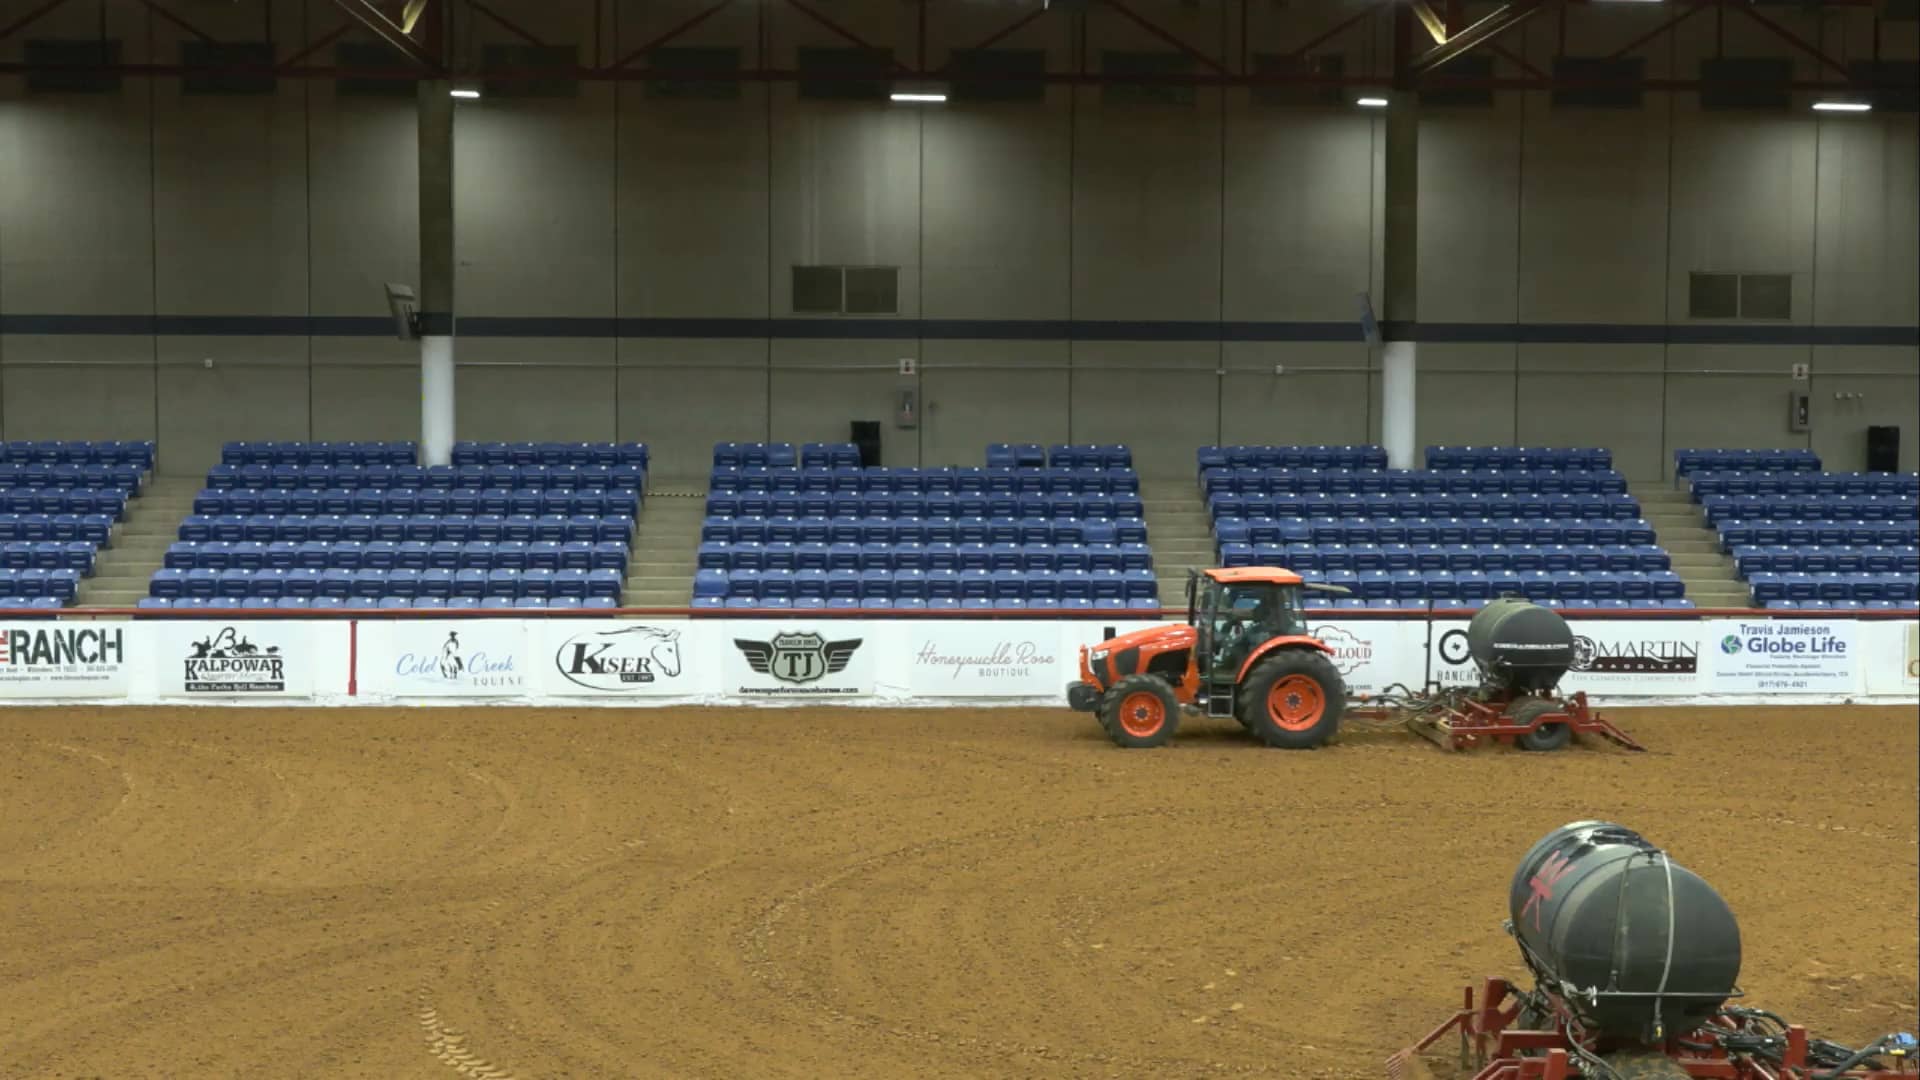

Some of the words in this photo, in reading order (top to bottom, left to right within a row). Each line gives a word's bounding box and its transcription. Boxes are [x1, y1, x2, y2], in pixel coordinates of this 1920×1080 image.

[1740, 624, 1773, 635] Travis
[1777, 624, 1830, 635] Jamieson
[10, 628, 123, 665] RANCH
[1598, 640, 1699, 662] MARTIN
[1747, 637, 1806, 653] Globe
[1811, 636, 1846, 653] Life
[184, 659, 284, 680] KALPOWAR
[396, 653, 439, 676] Cold
[467, 651, 514, 675] Creek
[783, 652, 814, 677] TJ
[978, 668, 1030, 677] BOUTIQUE
